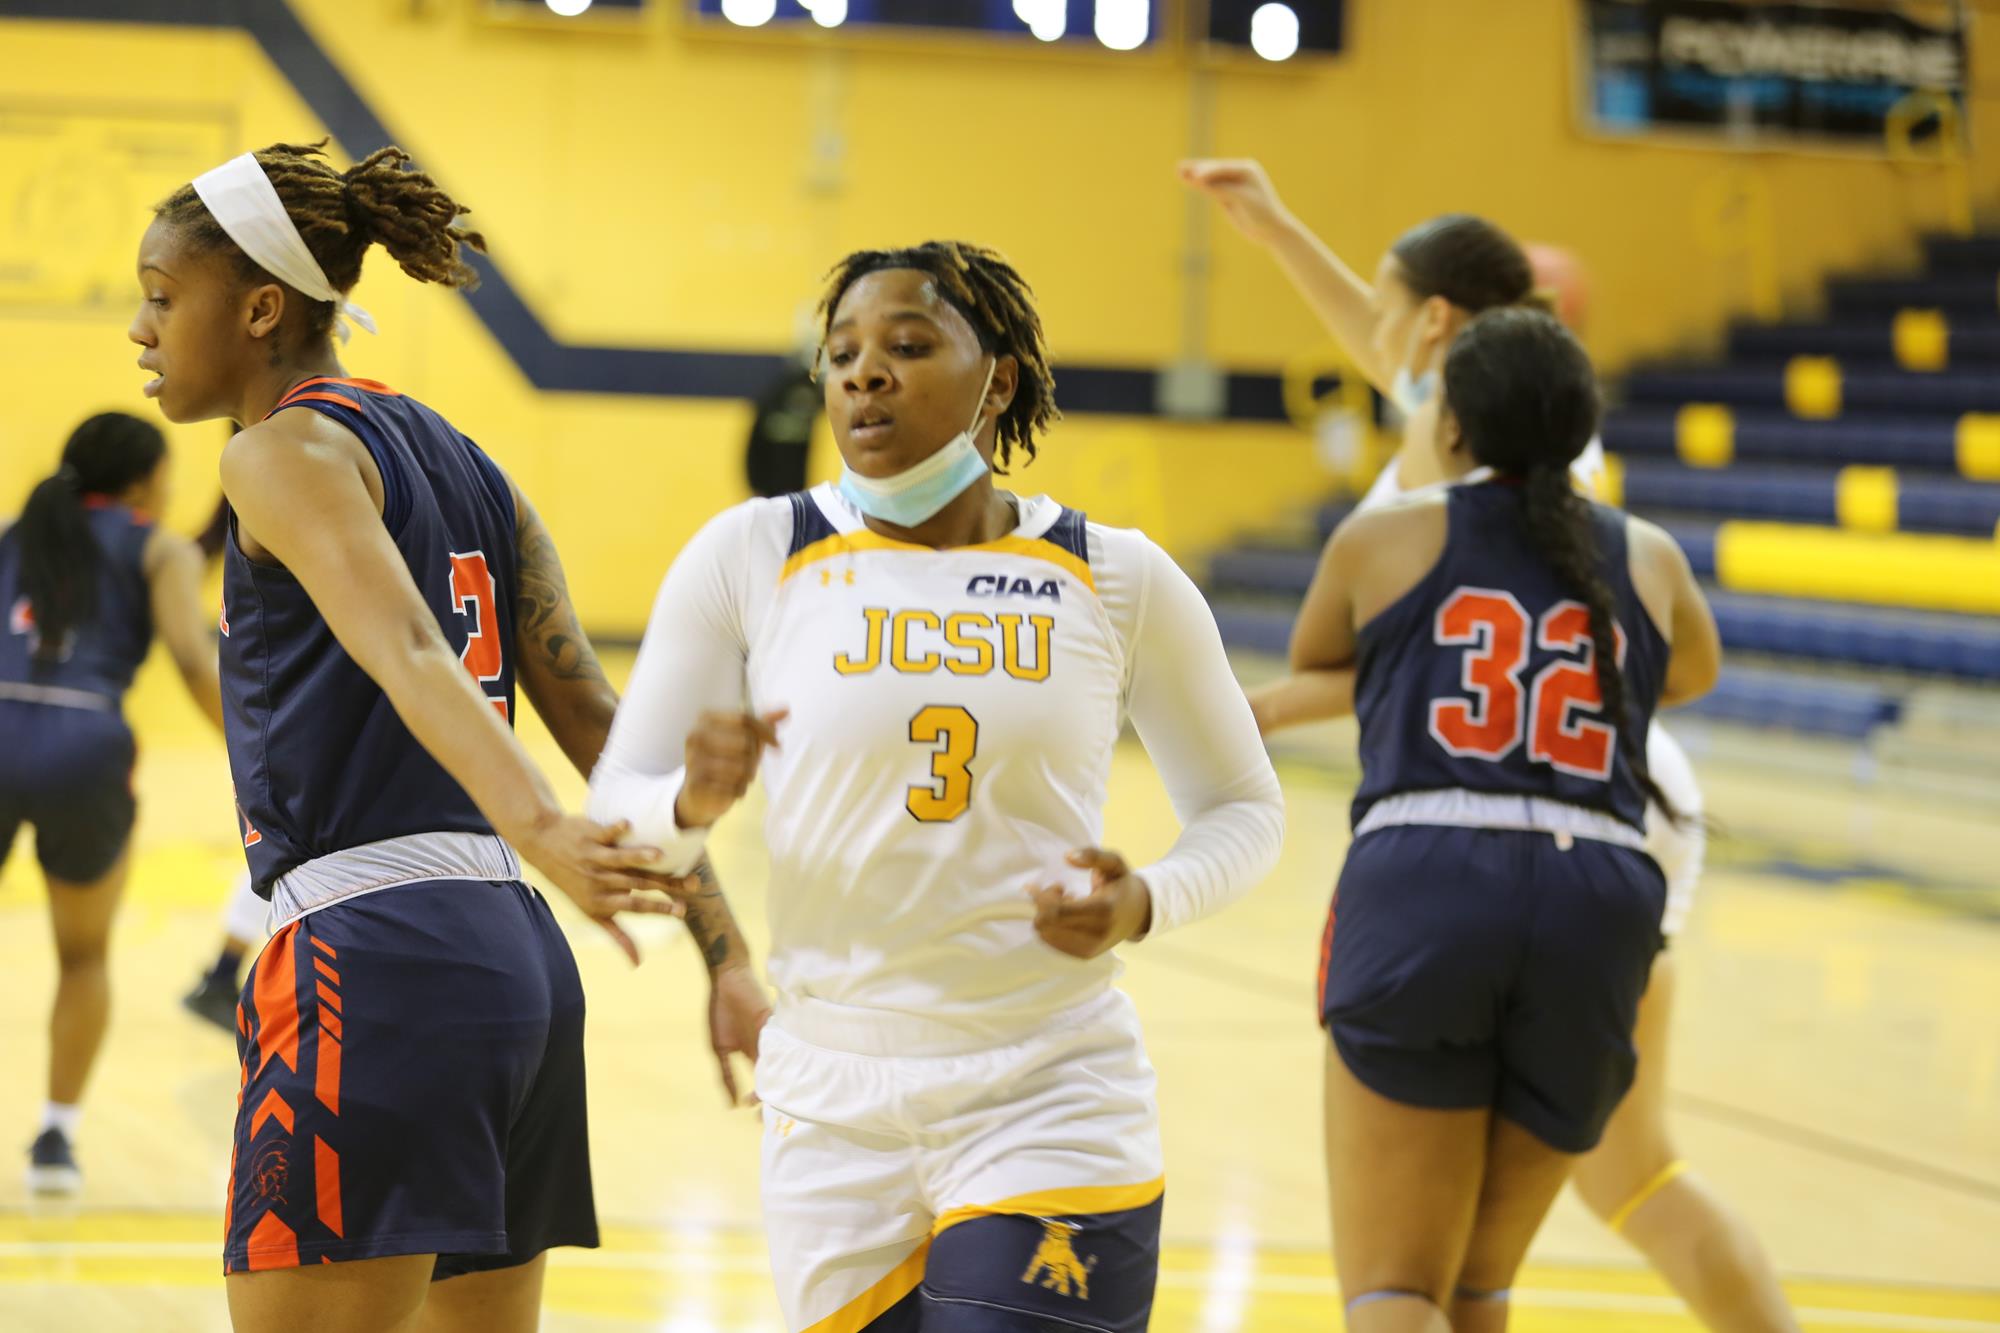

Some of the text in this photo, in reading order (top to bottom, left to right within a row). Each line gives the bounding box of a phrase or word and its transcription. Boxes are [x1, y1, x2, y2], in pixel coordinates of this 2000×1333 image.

[966, 575, 1062, 604] CIAA
[833, 607, 1054, 683] JCSU
[1428, 586, 1628, 783] 32
[905, 704, 979, 822] 3
